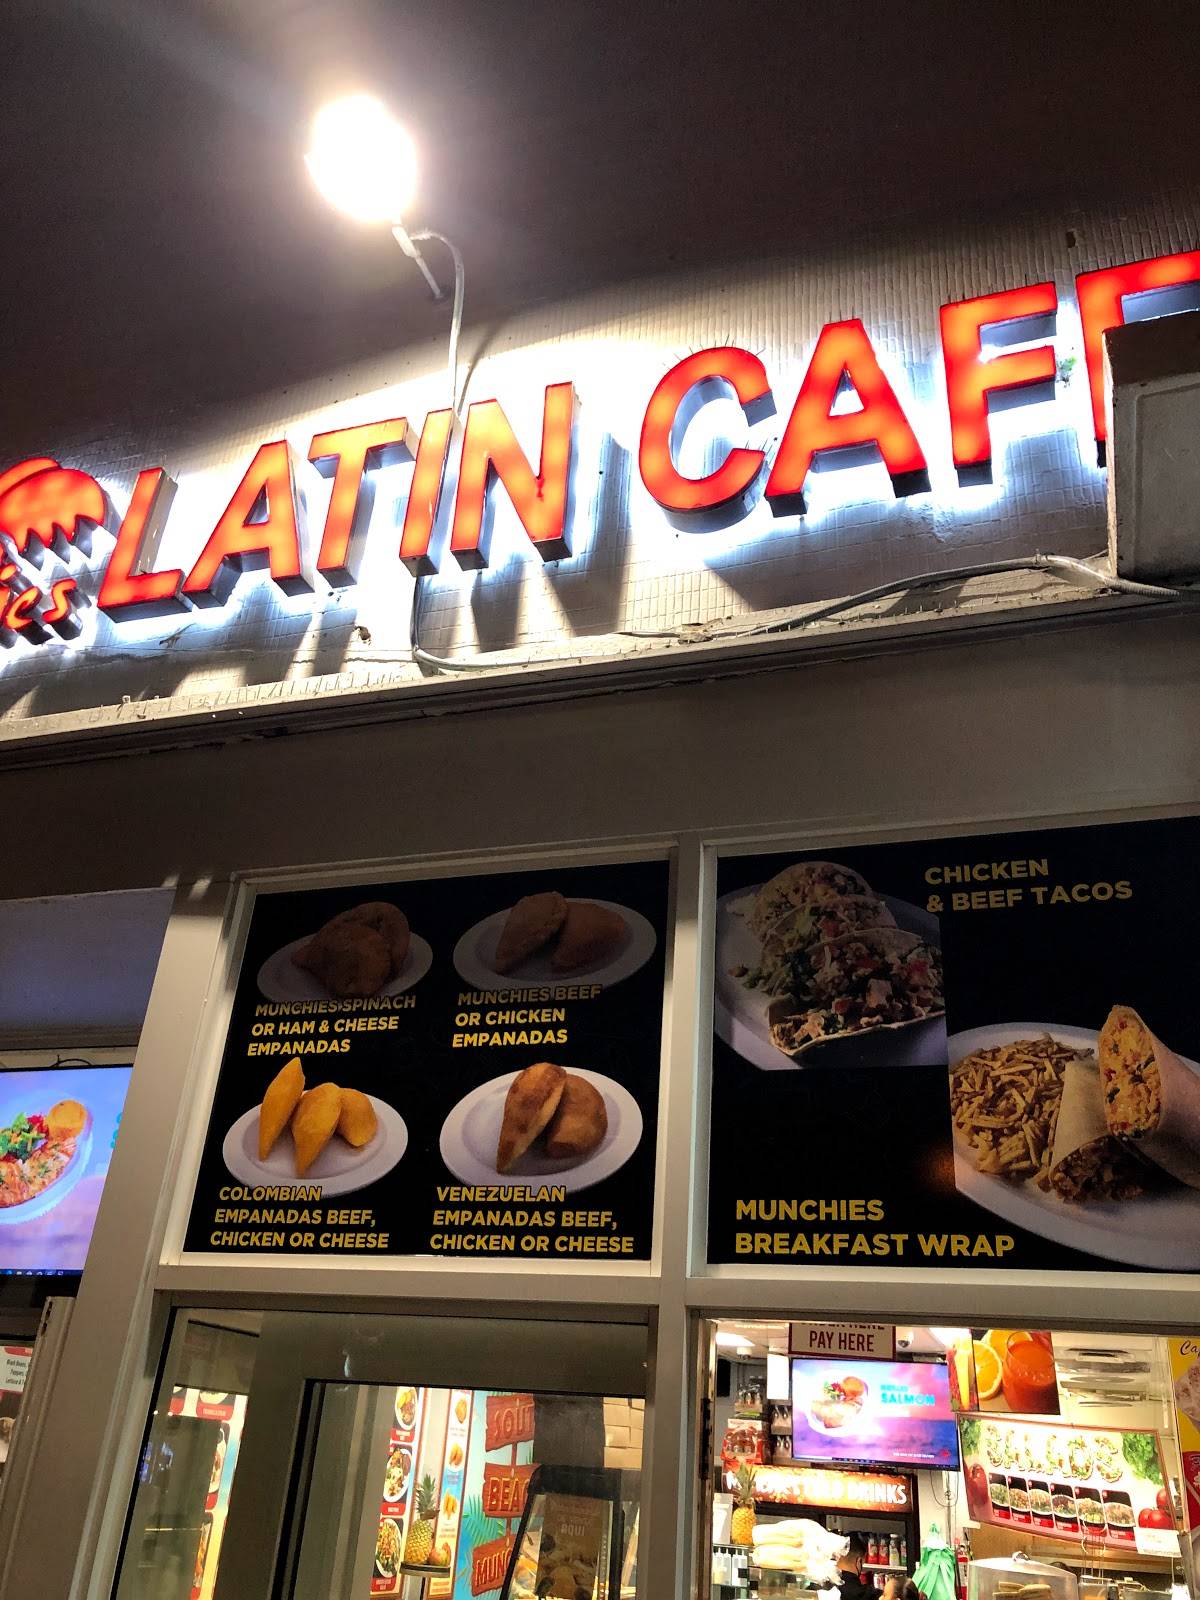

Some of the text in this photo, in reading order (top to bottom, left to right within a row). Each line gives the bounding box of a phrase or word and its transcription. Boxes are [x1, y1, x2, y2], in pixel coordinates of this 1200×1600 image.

[98, 381, 574, 610] LATIN
[924, 858, 1050, 885] CHICKEN
[926, 880, 1133, 913] & BEEF TACOS
[455, 984, 603, 1006] MUNCHIES BEEF
[255, 995, 417, 1017] MUNCHIES SPINACH
[251, 1015, 400, 1037] OR HAM & CHEESE
[455, 1007, 566, 1027] OR CHICKEN
[247, 1038, 351, 1057] EMPANADAS
[452, 1029, 568, 1048] EMPANADAS
[219, 1185, 322, 1202] COLOMBIAN
[436, 1185, 566, 1202] VENEZUELAN
[214, 1208, 376, 1227] EMPANADAS BEEF,
[432, 1210, 618, 1230] EMPANADAS BEEF,
[735, 1199, 885, 1221] MUNCHIES
[210, 1231, 390, 1249] CHICKEN OR CHEESE
[429, 1233, 634, 1253] CHICKEN OR CHEESE
[735, 1232, 1015, 1257] BREAKFAST WRAP
[809, 1330, 875, 1352] PAY HERE
[881, 1392, 935, 1406] SALMON
[847, 1481, 907, 1505] DRINKS
